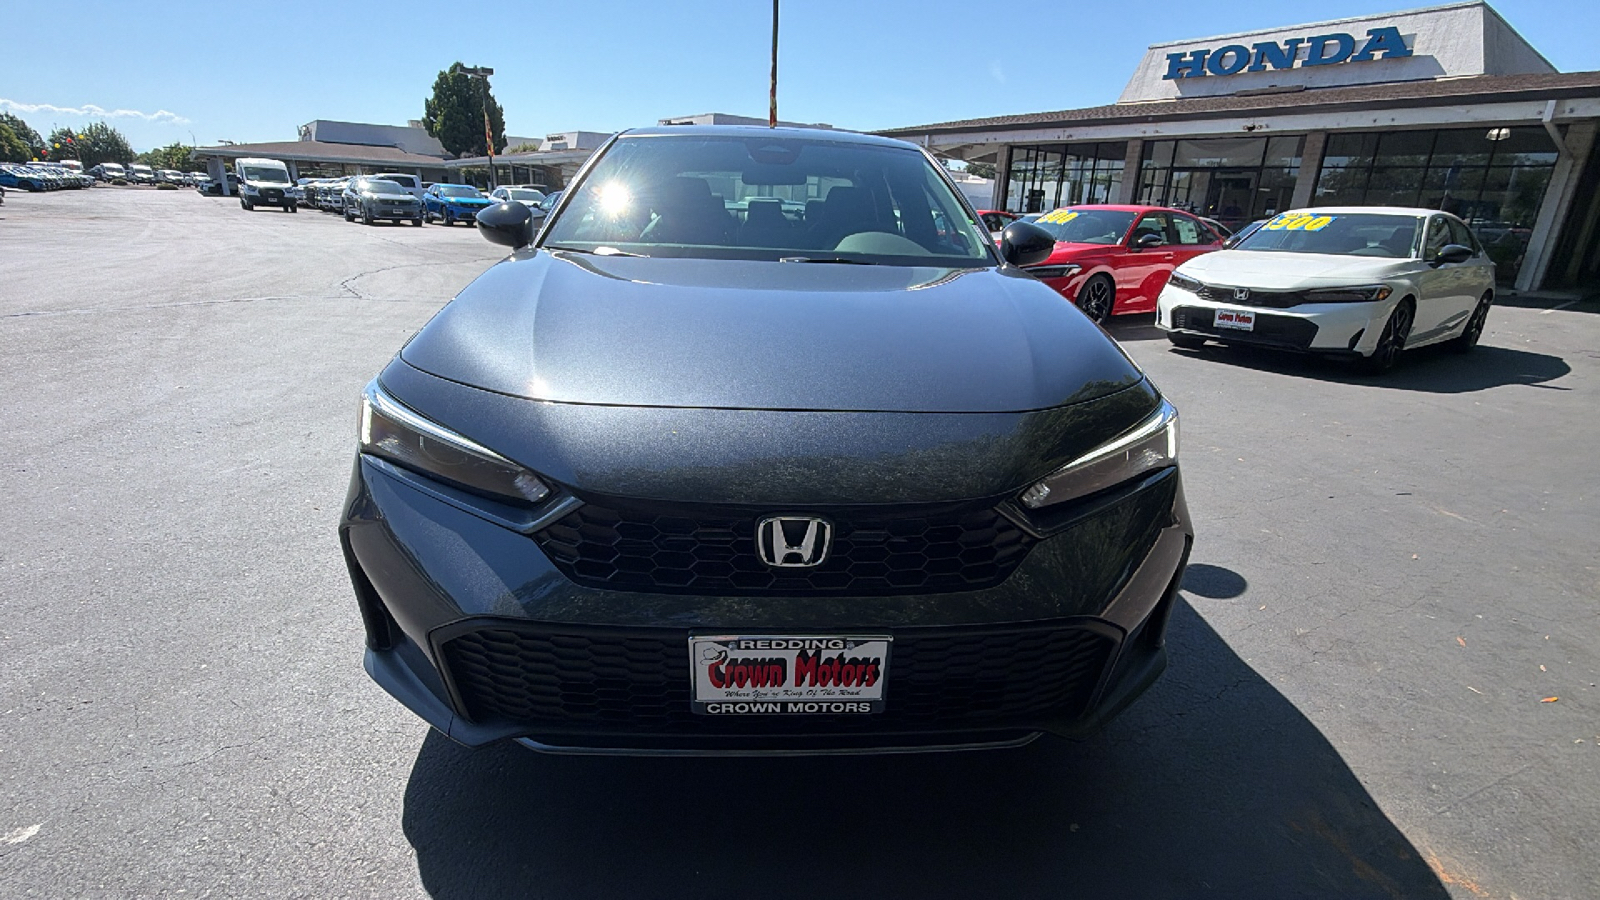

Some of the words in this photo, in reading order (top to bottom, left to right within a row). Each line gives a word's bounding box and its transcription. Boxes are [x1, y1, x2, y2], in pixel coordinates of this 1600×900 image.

[1162, 26, 1414, 81] HONDA
[739, 639, 844, 650] REDDING
[708, 651, 788, 689] Crown
[794, 649, 881, 688] Motors
[724, 689, 750, 697] Where
[783, 689, 803, 698] King
[806, 689, 818, 698] Of
[820, 688, 836, 696] The
[706, 702, 781, 714] CROWN
[787, 702, 871, 713] MOTORS
